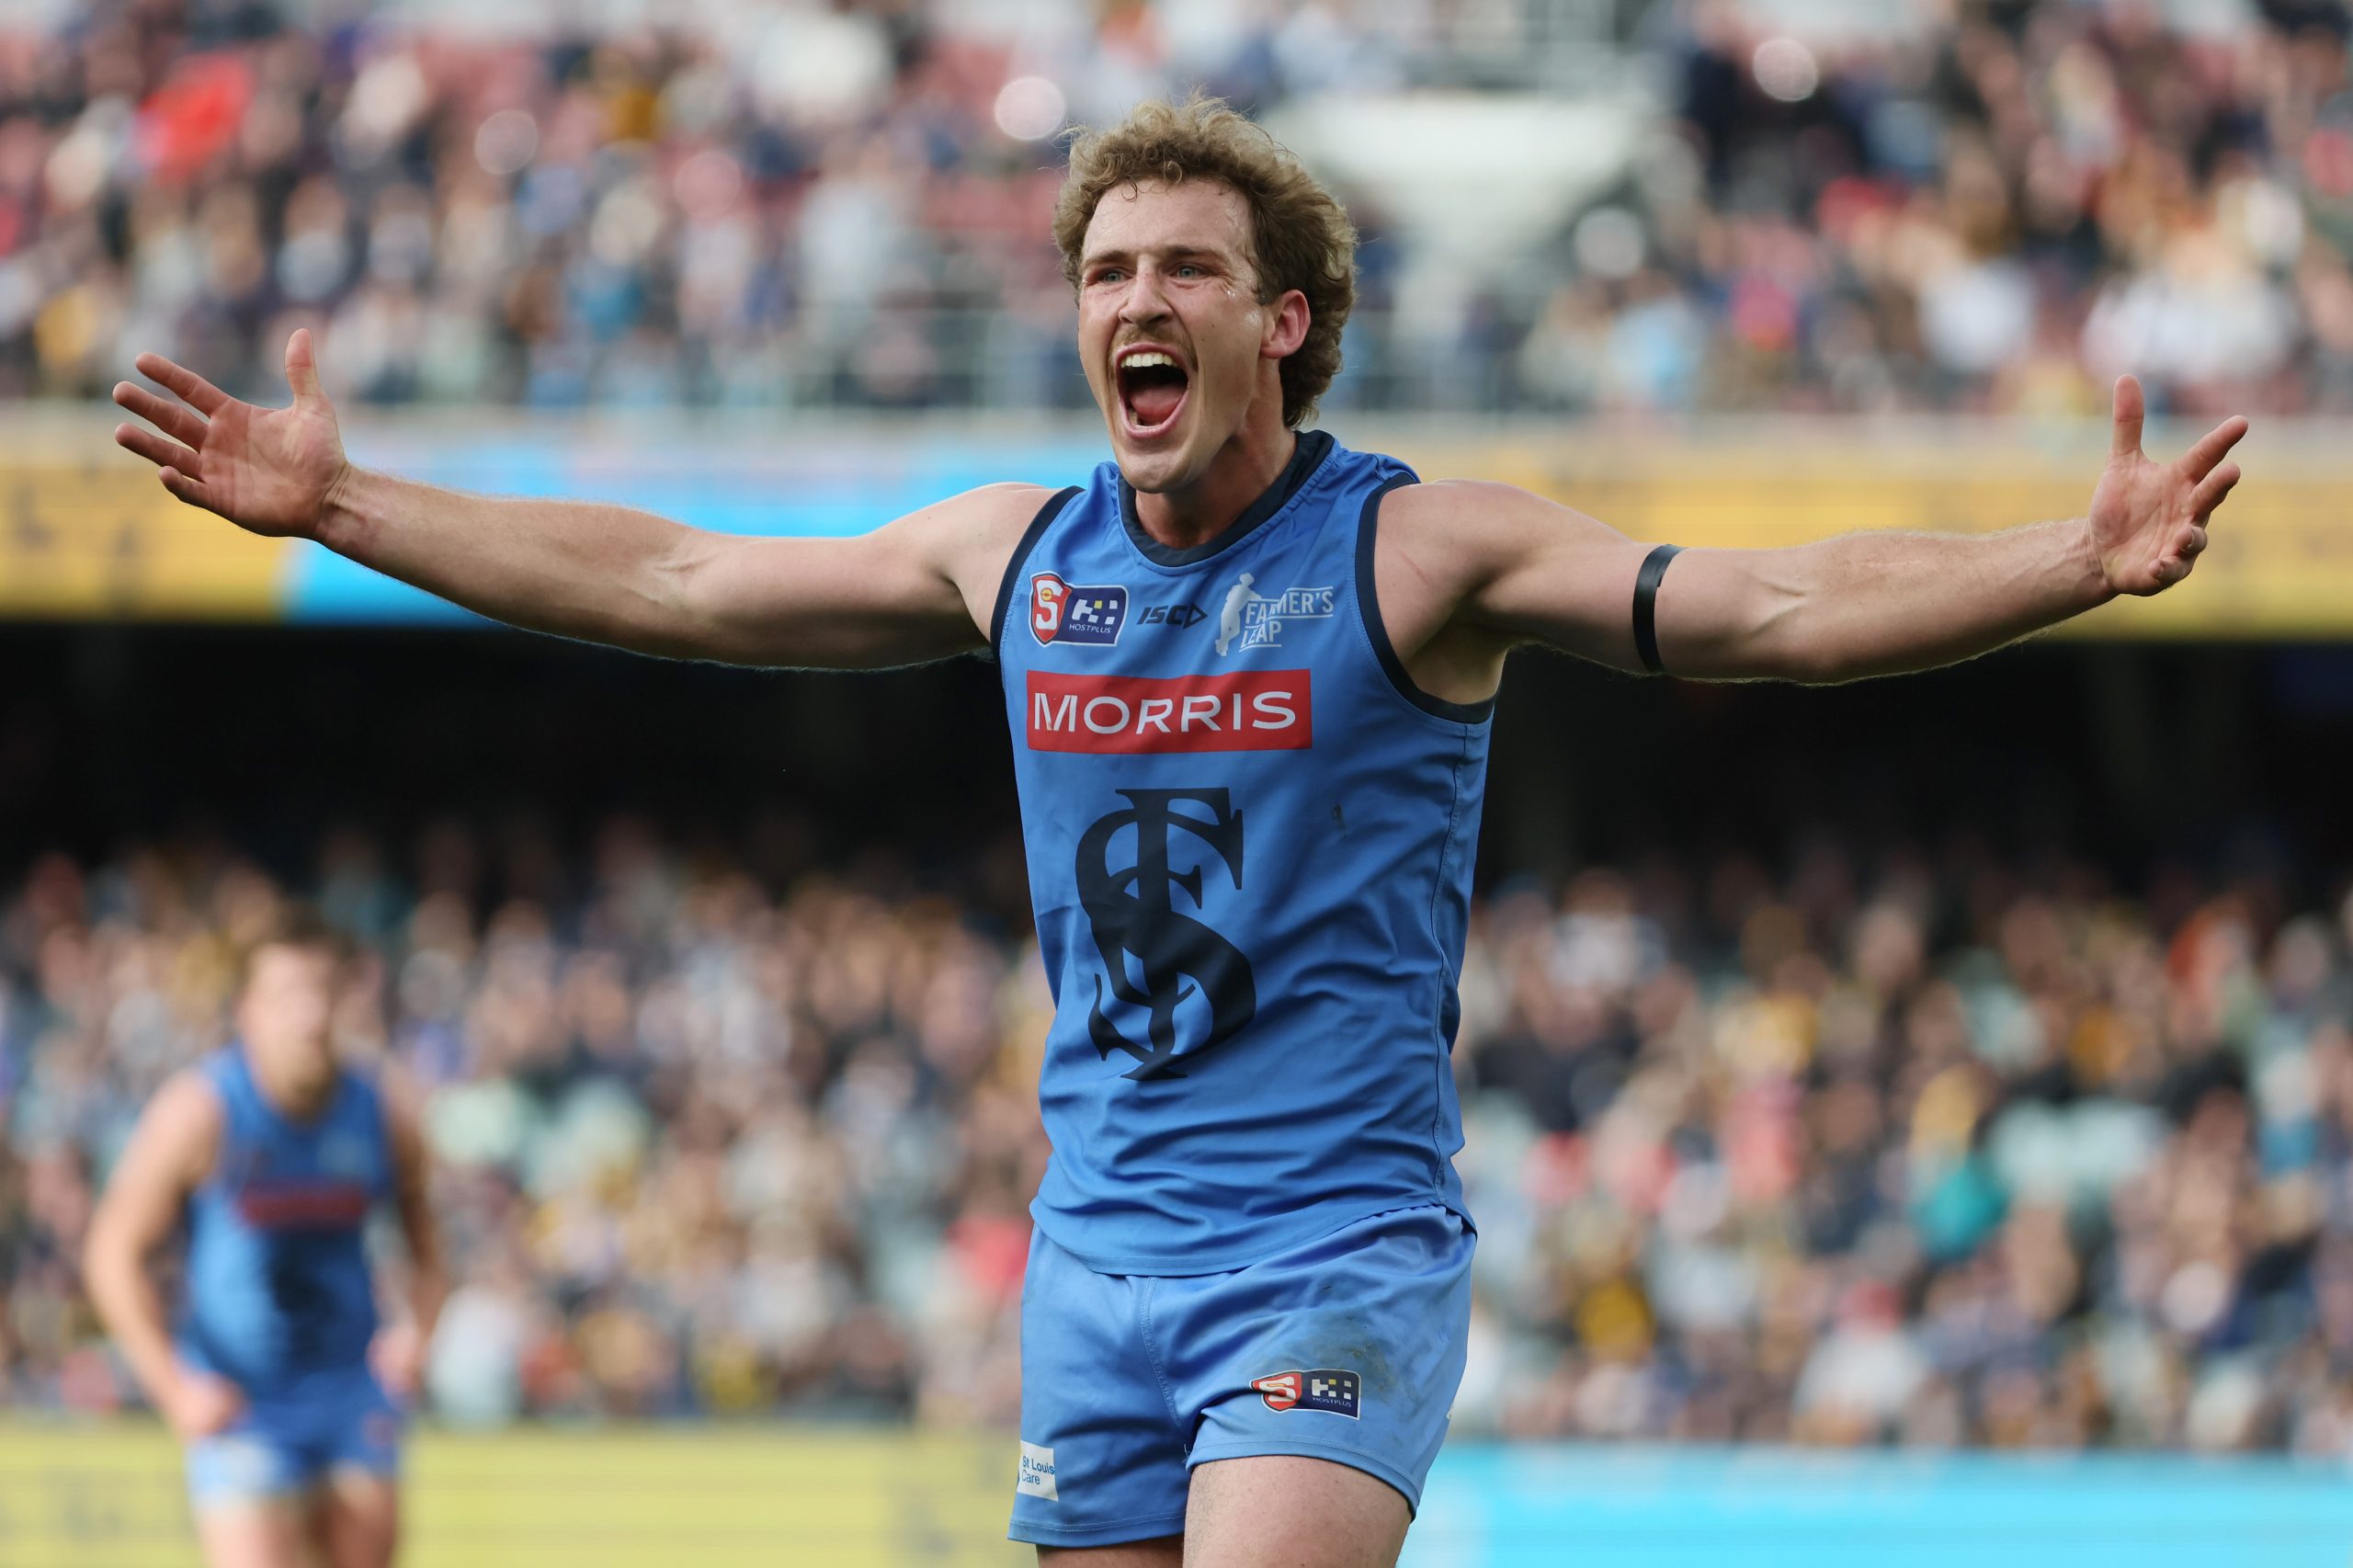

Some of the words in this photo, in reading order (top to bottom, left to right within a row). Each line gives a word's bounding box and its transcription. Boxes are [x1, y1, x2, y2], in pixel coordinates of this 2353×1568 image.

[1136, 604, 1188, 626] ISC
[1245, 590, 1335, 625] FAMER'S
[1069, 622, 1112, 634] HOSTPLUS
[1034, 690, 1297, 734] MORRIS
[1022, 1455, 1030, 1469] St
[1031, 1458, 1055, 1475] Louis
[1021, 1469, 1040, 1485] Care
